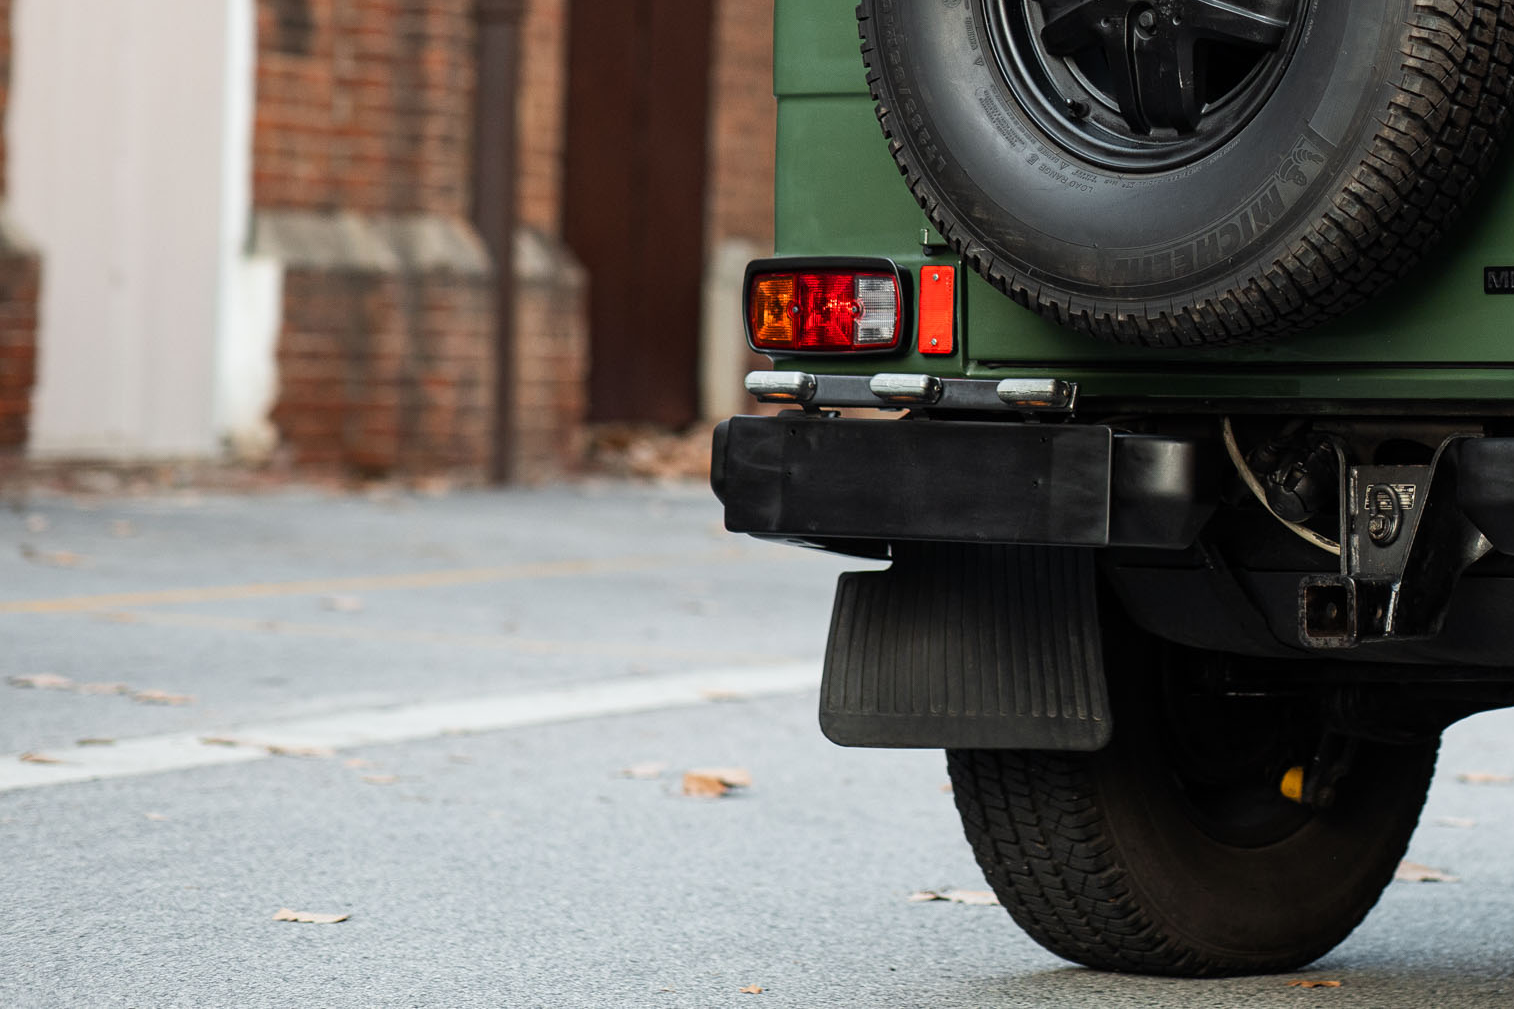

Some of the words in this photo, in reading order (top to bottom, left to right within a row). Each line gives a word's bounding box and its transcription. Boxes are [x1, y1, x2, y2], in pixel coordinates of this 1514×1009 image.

[1038, 162, 1070, 185] RANGE
[1068, 178, 1095, 194] LOAD
[1114, 182, 1286, 278] MICHELIN
